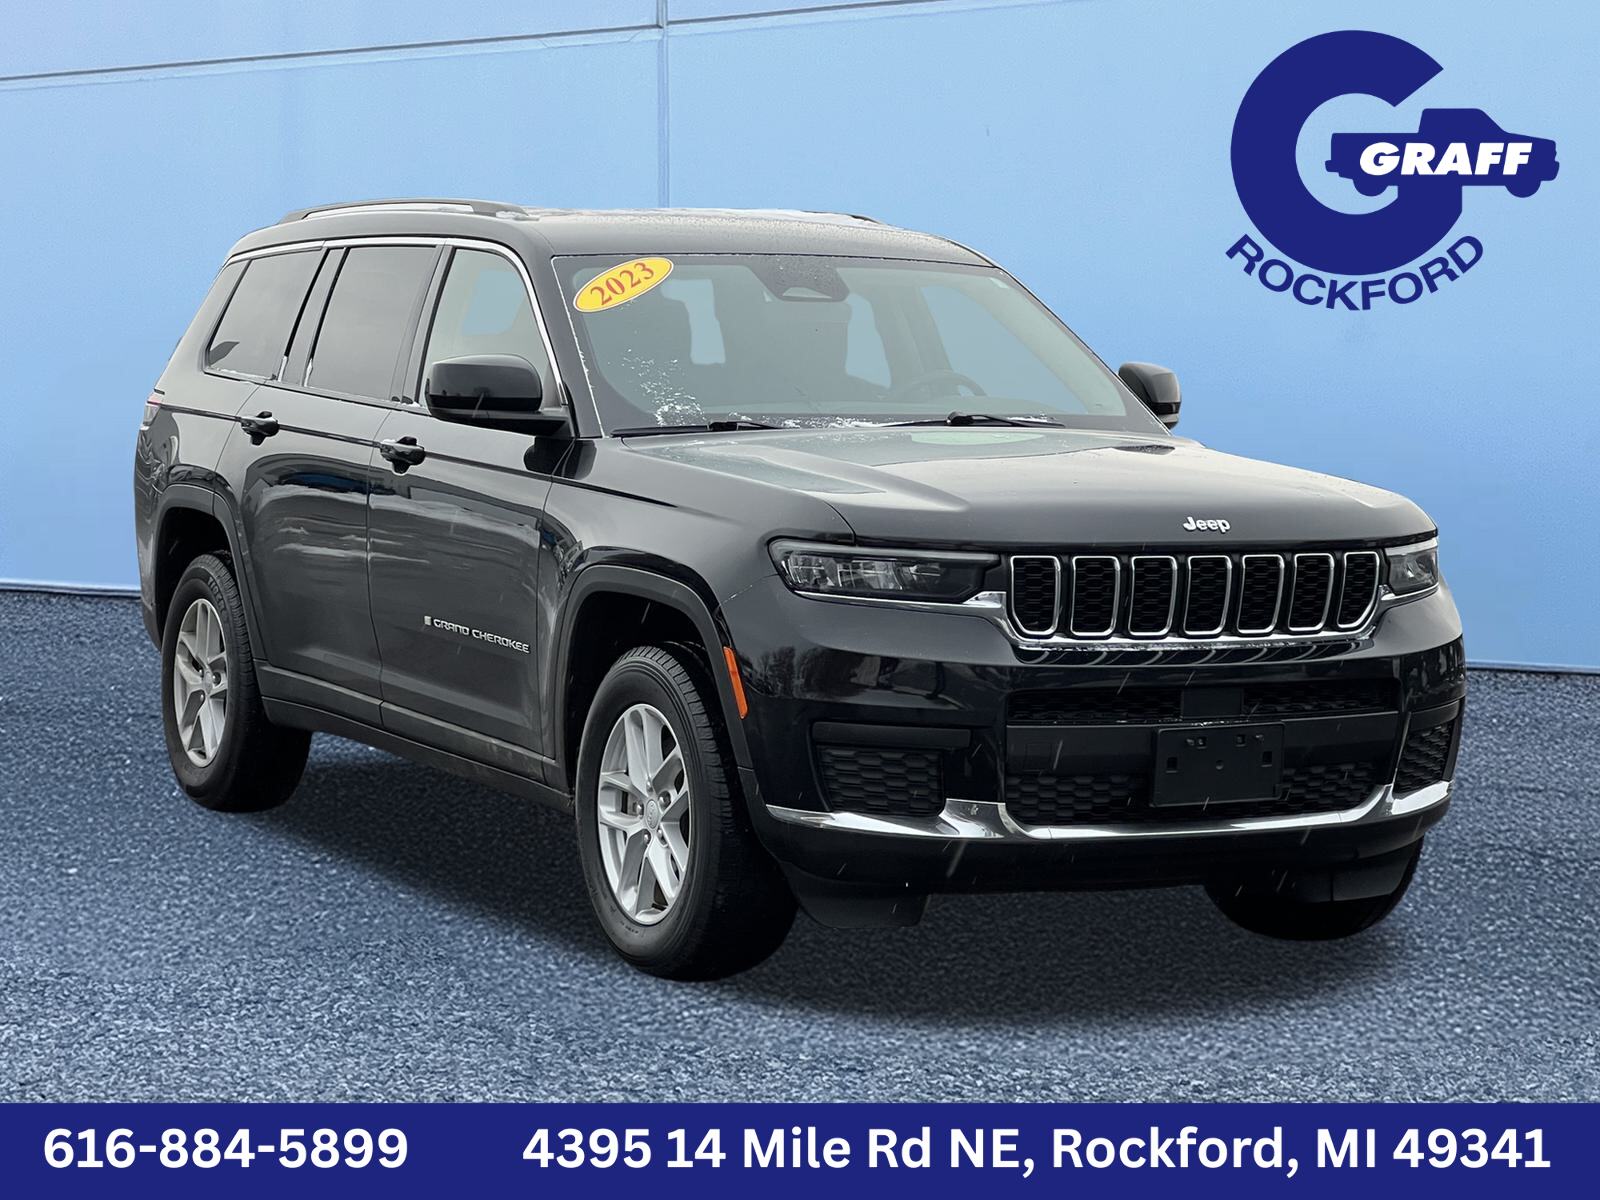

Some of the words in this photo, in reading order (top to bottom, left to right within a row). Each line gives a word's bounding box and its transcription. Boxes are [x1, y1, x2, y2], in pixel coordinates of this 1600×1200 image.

[590, 262, 655, 306] 2023
[1183, 516, 1231, 533] Jeep
[433, 618, 470, 636] GRAND
[471, 629, 530, 654] CHEROKEE
